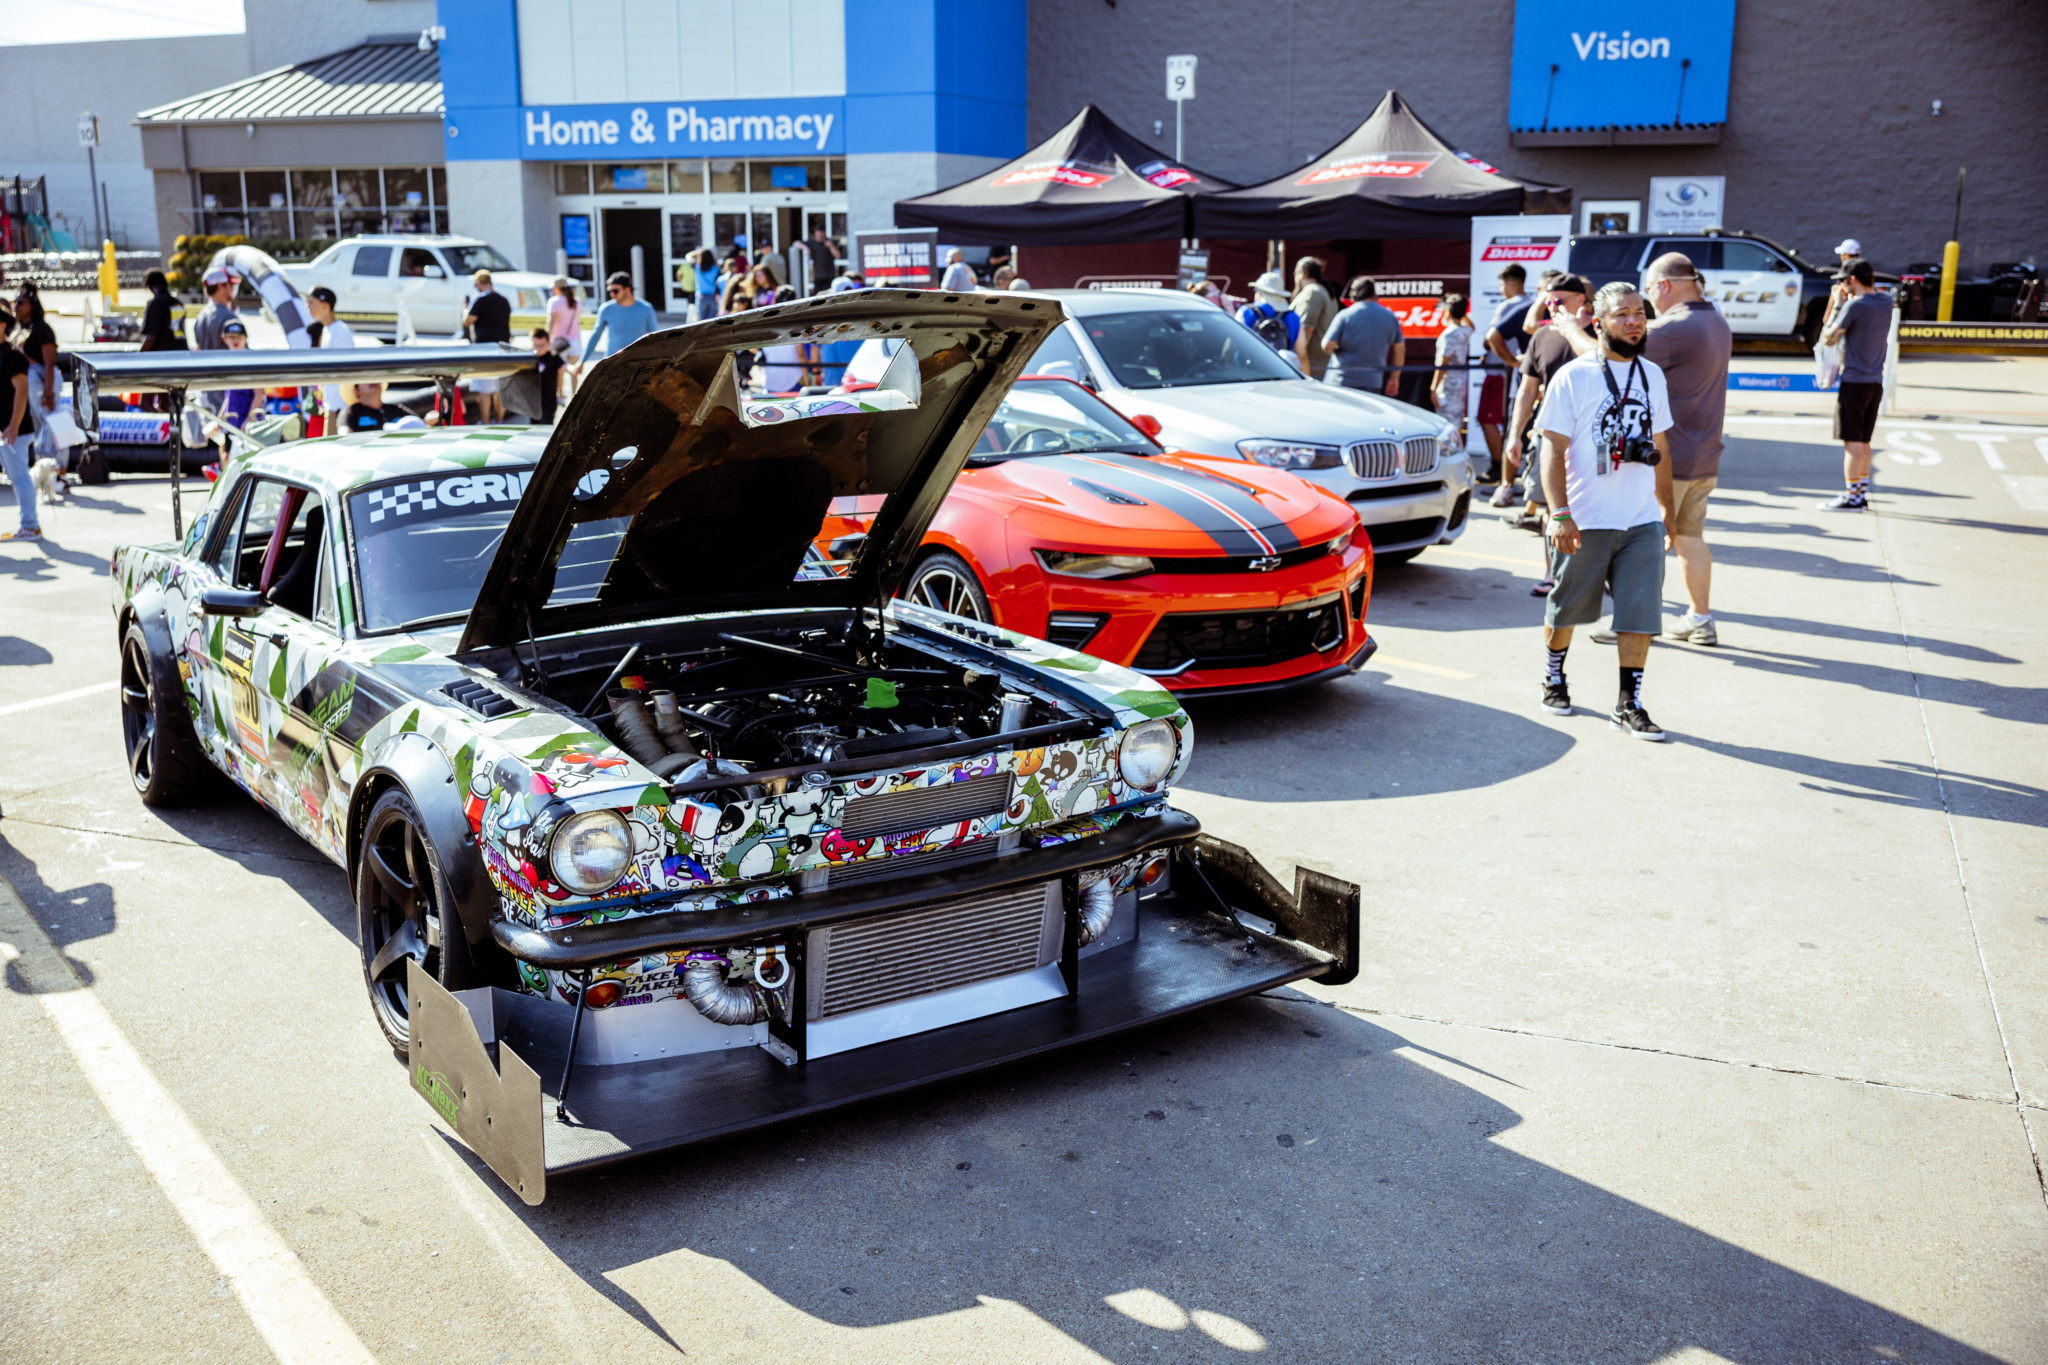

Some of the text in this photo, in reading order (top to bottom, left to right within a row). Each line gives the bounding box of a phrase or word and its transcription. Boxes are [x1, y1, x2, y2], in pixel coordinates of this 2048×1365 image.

[1571, 30, 1670, 61] Vision
[1175, 75, 1186, 91] 9
[80, 128, 95, 141] 10
[526, 106, 834, 151] Home & Pharmacy
[1310, 162, 1414, 182] Dickies
[1486, 248, 1549, 259] Dickies
[1374, 281, 1444, 295] ENUINE
[1737, 376, 1777, 388] Walmart
[508, 867, 534, 896] MIND
[500, 873, 537, 917] FREE
